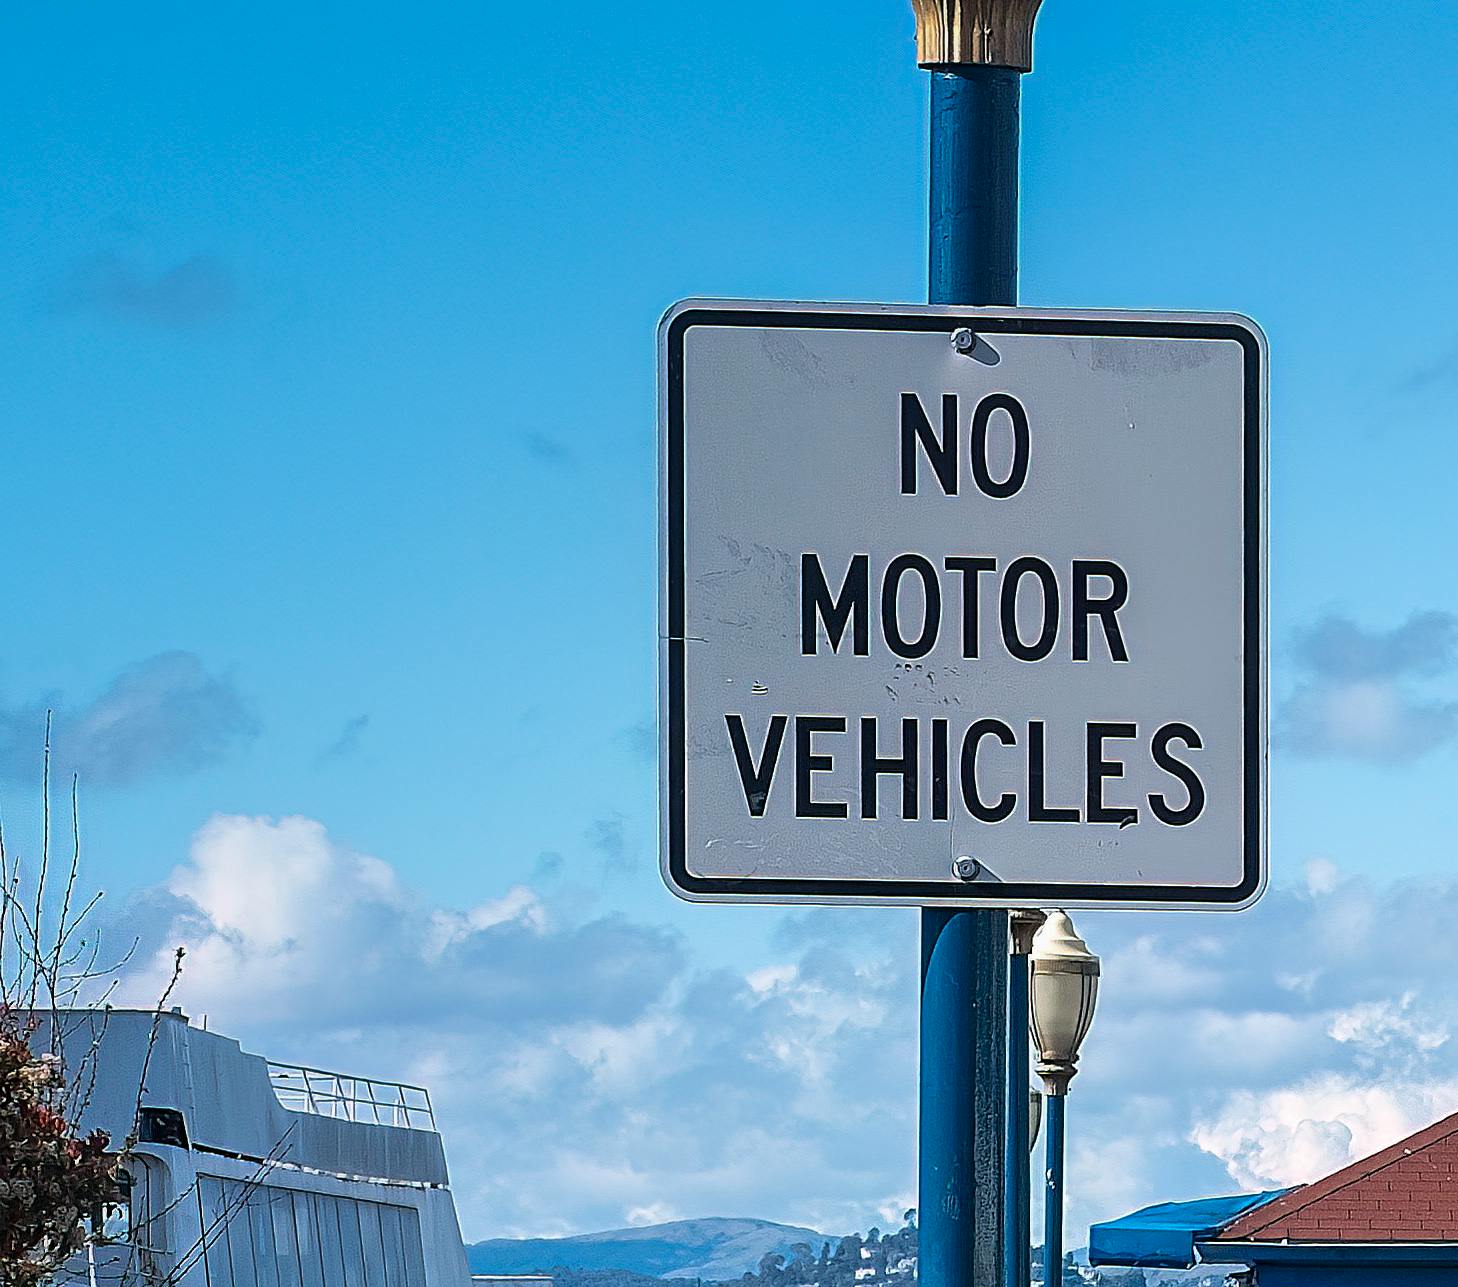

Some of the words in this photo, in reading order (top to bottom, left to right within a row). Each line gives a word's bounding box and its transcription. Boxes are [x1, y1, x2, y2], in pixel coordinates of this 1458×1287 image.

[900, 392, 1030, 499] NO
[801, 553, 1129, 662] MOTOR
[724, 714, 1205, 827] VEHICLES
